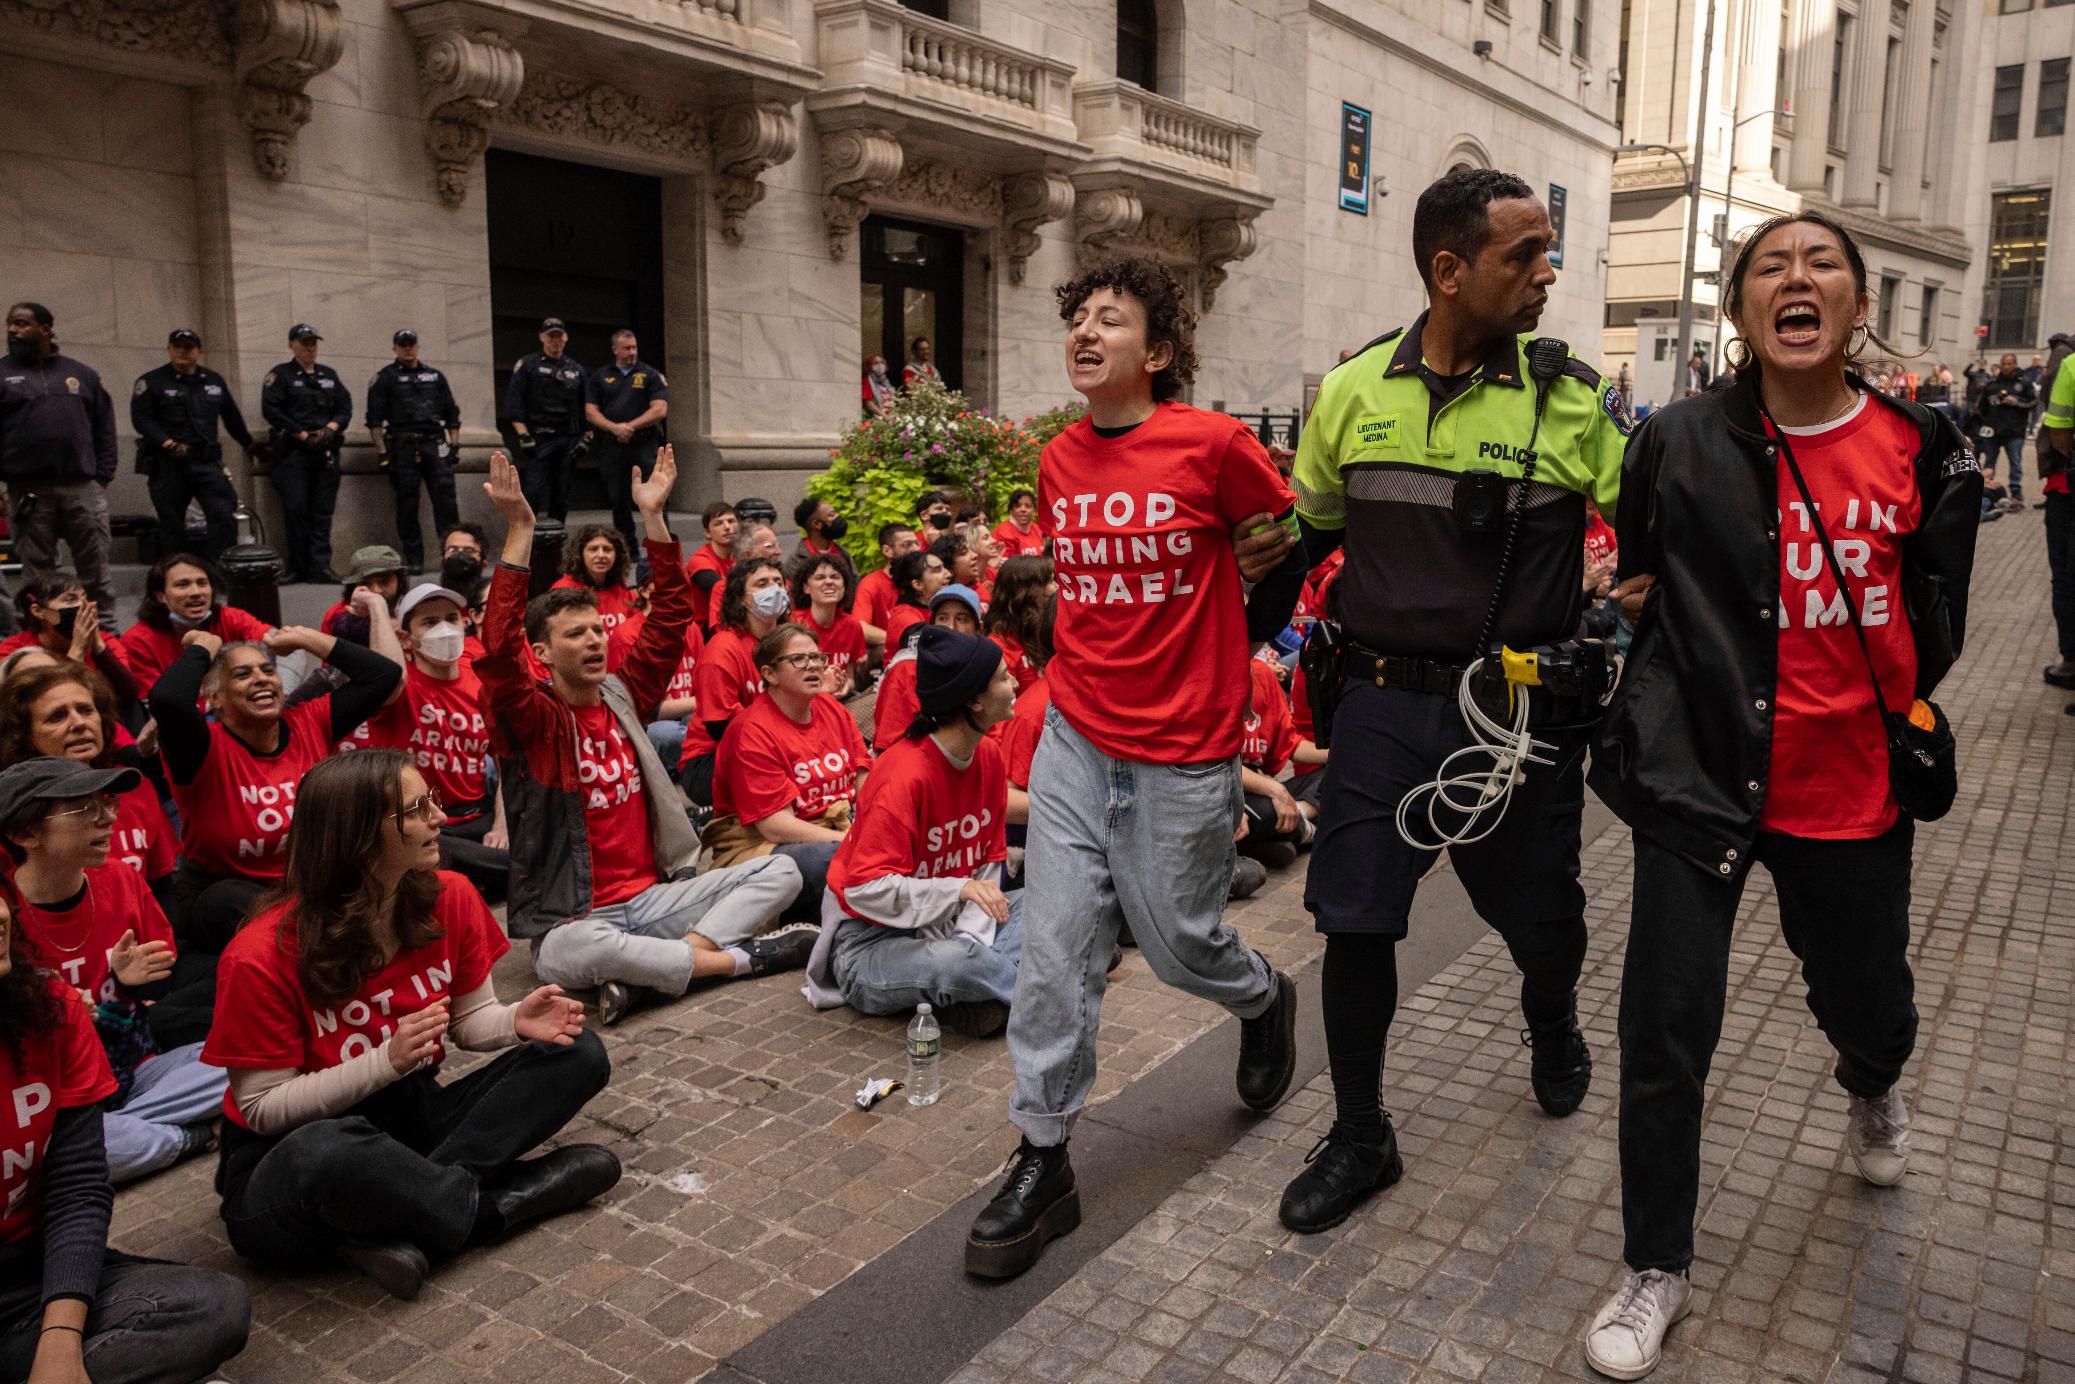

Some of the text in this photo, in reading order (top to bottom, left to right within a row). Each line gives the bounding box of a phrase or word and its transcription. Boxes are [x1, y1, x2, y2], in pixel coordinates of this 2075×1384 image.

[1357, 419, 1396, 434] LIEUTENANT
[1363, 431, 1389, 443] MEDINA
[1478, 441, 1530, 465] POLIC
[1052, 491, 1176, 531] STOP
[1845, 499, 1898, 533] IN
[1053, 530, 1192, 565] RMING
[1786, 539, 1871, 580] UR
[1058, 568, 1194, 604] SRAEL
[1778, 584, 1890, 629] ME
[419, 703, 485, 733] STOP
[239, 781, 296, 805] NOT
[586, 767, 641, 810] AME
[119, 828, 148, 851] IN
[927, 807, 991, 853] STOP
[313, 958, 453, 1038] NOT IN
